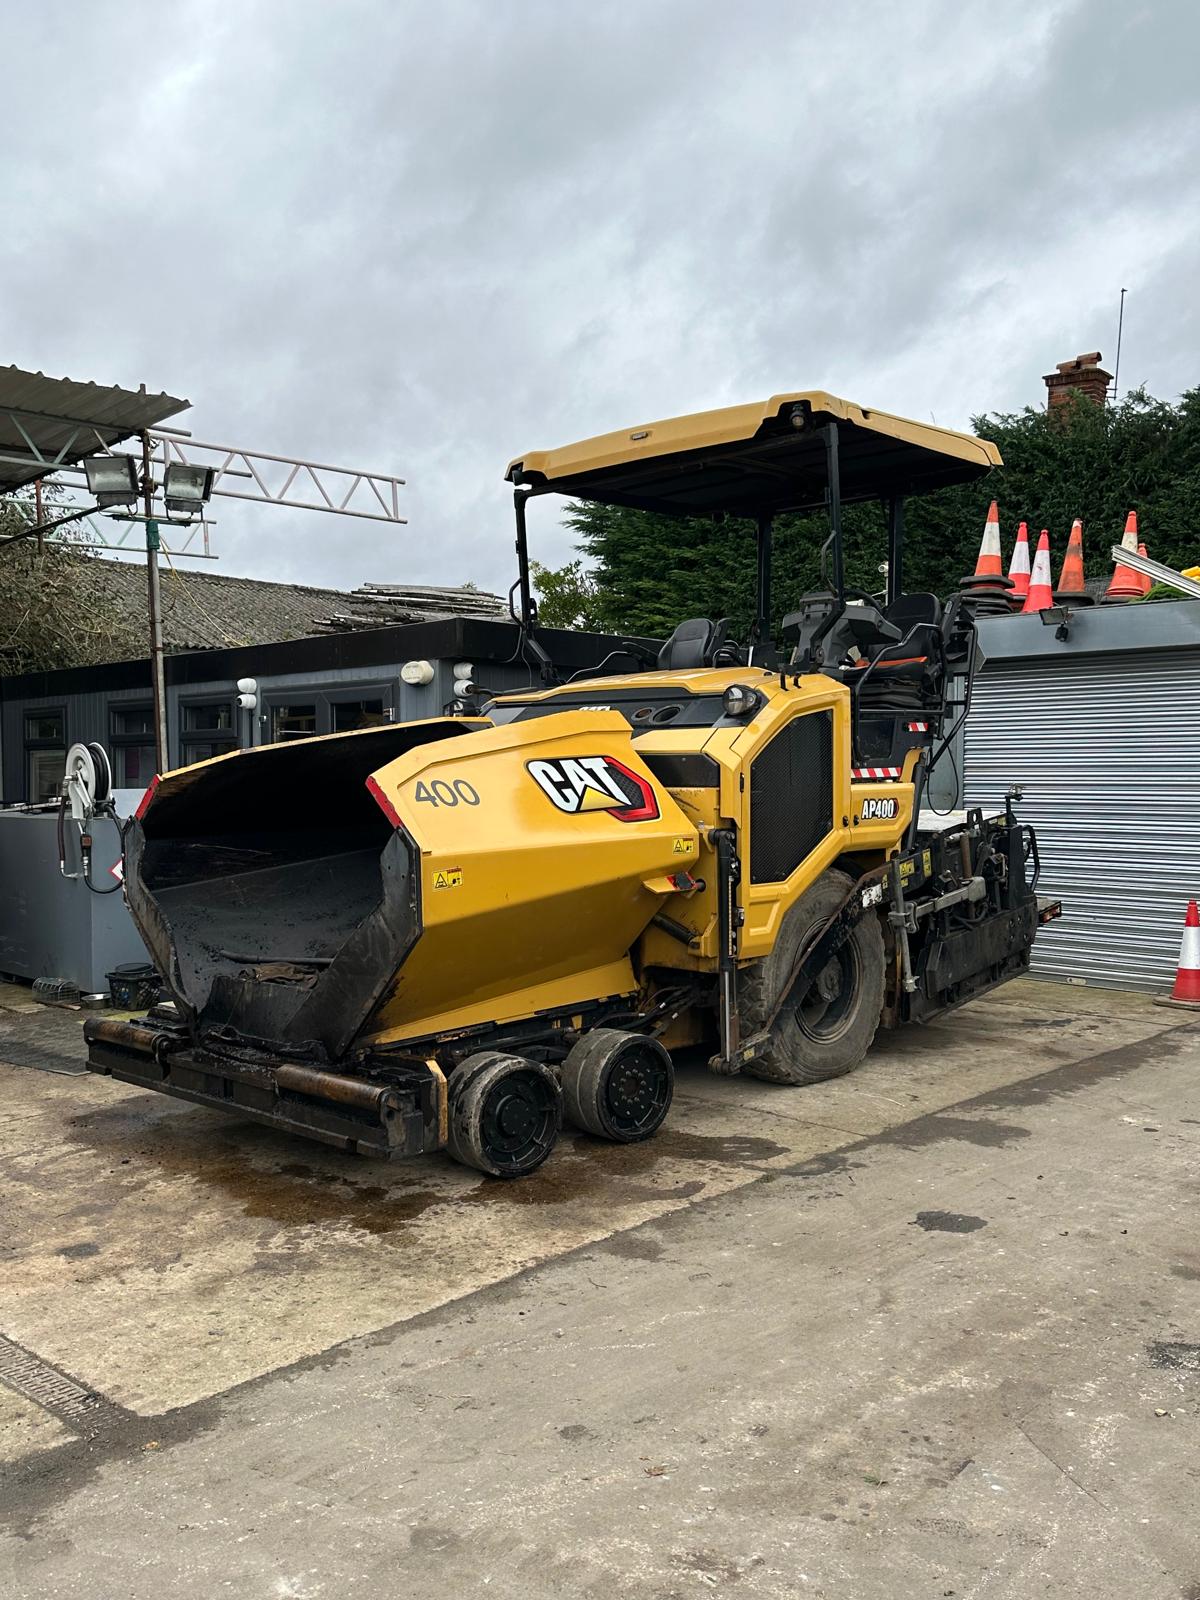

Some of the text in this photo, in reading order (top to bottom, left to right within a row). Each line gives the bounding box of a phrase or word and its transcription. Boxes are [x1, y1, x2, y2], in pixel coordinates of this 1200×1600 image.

[414, 779, 480, 808] 400
[527, 757, 632, 812] CAT
[861, 799, 895, 819] AP400
